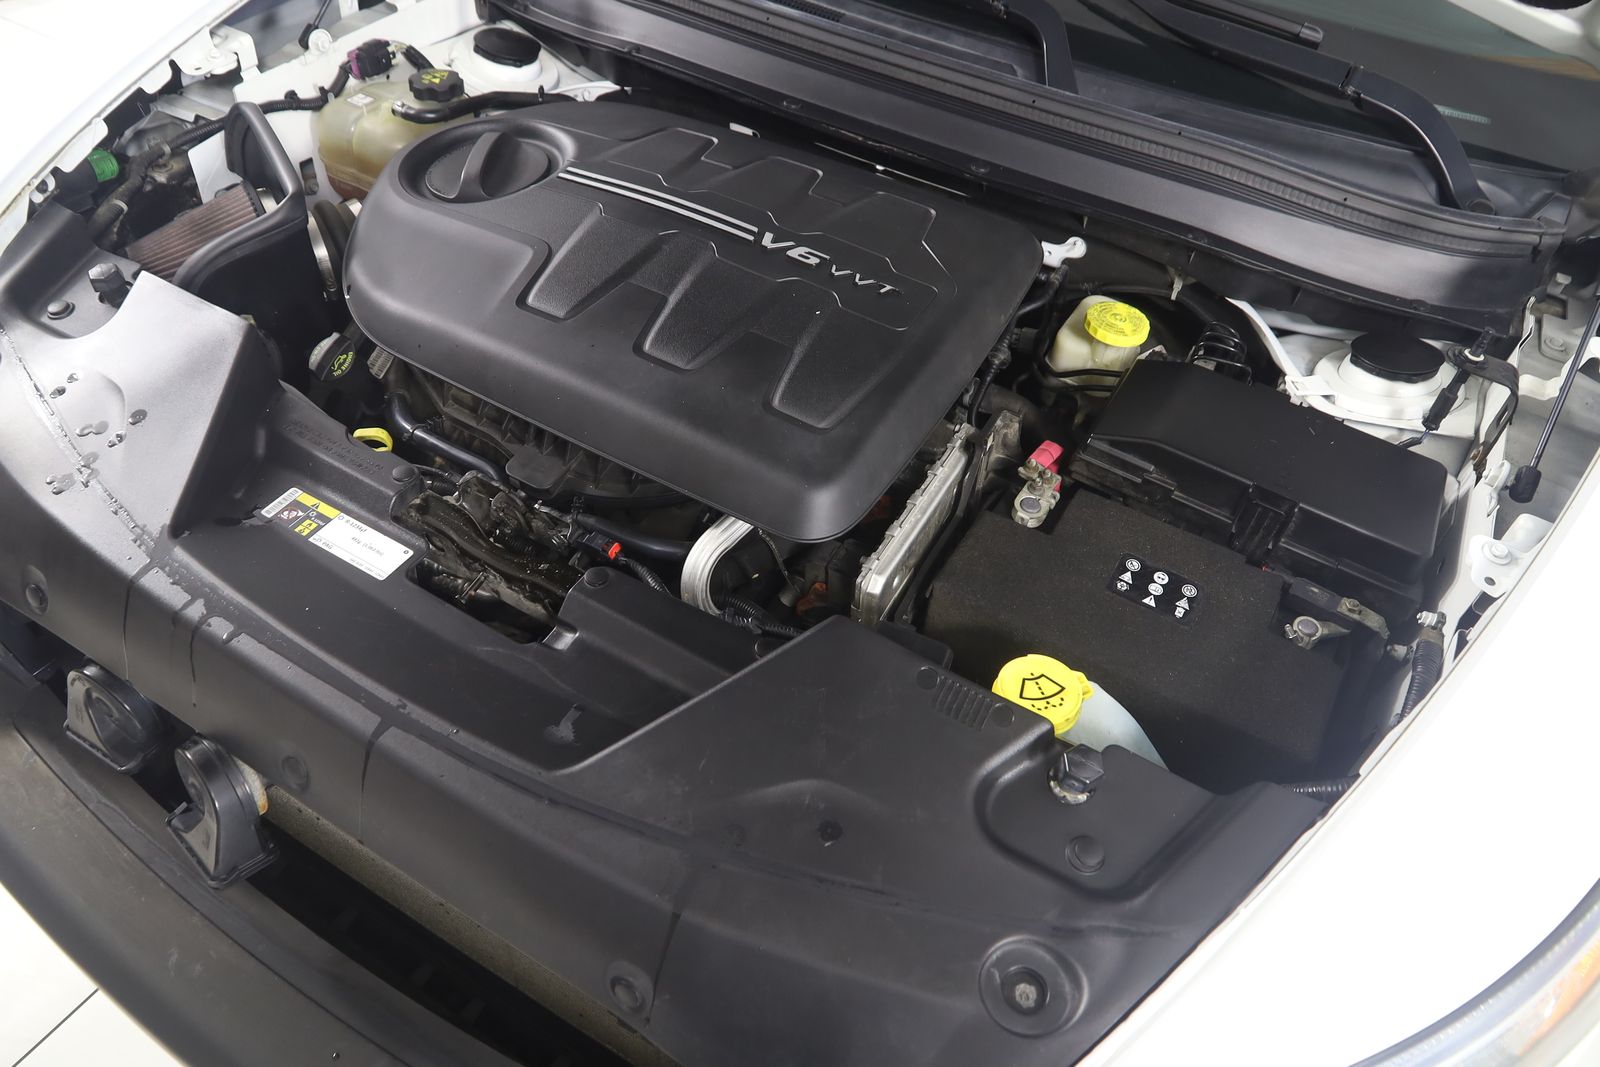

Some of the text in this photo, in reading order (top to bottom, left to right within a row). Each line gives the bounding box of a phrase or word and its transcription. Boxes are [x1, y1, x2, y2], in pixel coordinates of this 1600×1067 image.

[761, 231, 901, 295] V6 VVT
[340, 351, 354, 371] ENGINE
